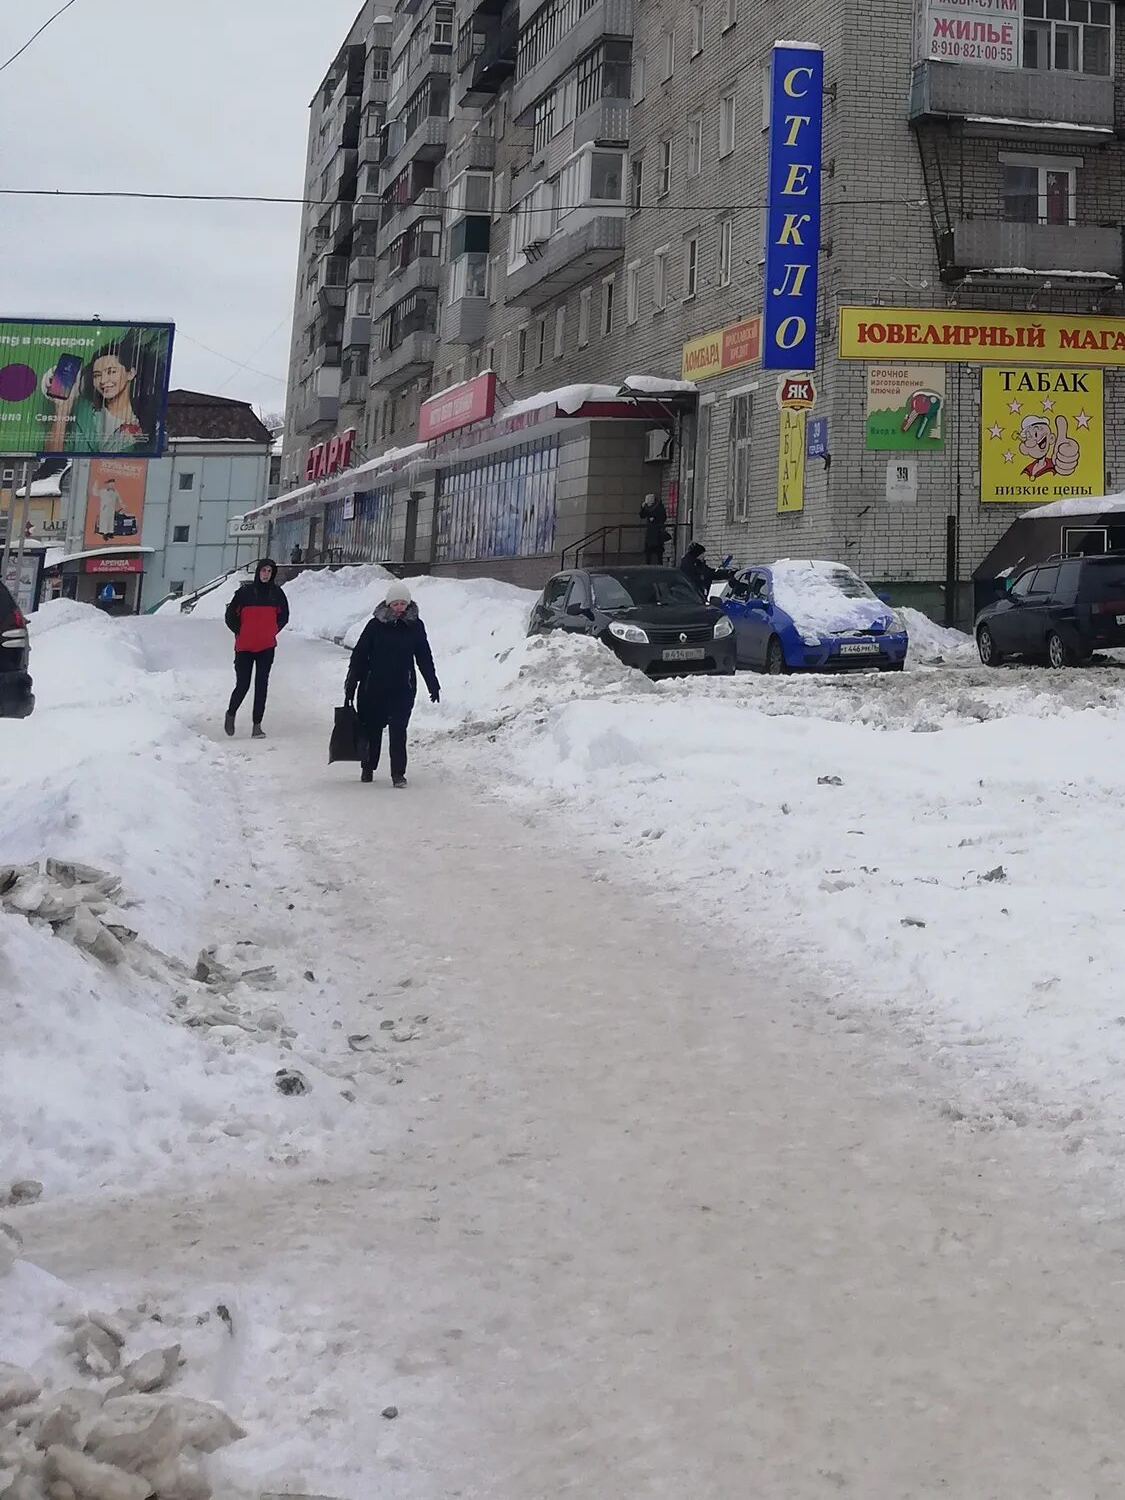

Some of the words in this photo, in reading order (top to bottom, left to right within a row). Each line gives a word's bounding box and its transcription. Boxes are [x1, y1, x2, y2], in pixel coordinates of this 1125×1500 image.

[932, 17, 1014, 46] ЖИЛЬЁ
[772, 66, 815, 350] СТЕКЛО
[857, 322, 1046, 348] ЮВЕЛИРНЫЙ
[685, 341, 720, 373] ЛОМБАРД
[870, 369, 909, 378] СРОЧНОЕ
[870, 379, 924, 387] изготовление
[999, 371, 1090, 393] ТАБАК
[787, 384, 809, 399] ЯК
[870, 387, 901, 395] ключей
[781, 411, 792, 506] АБАК
[995, 485, 1049, 496] низкие
[1053, 485, 1093, 497] цены
